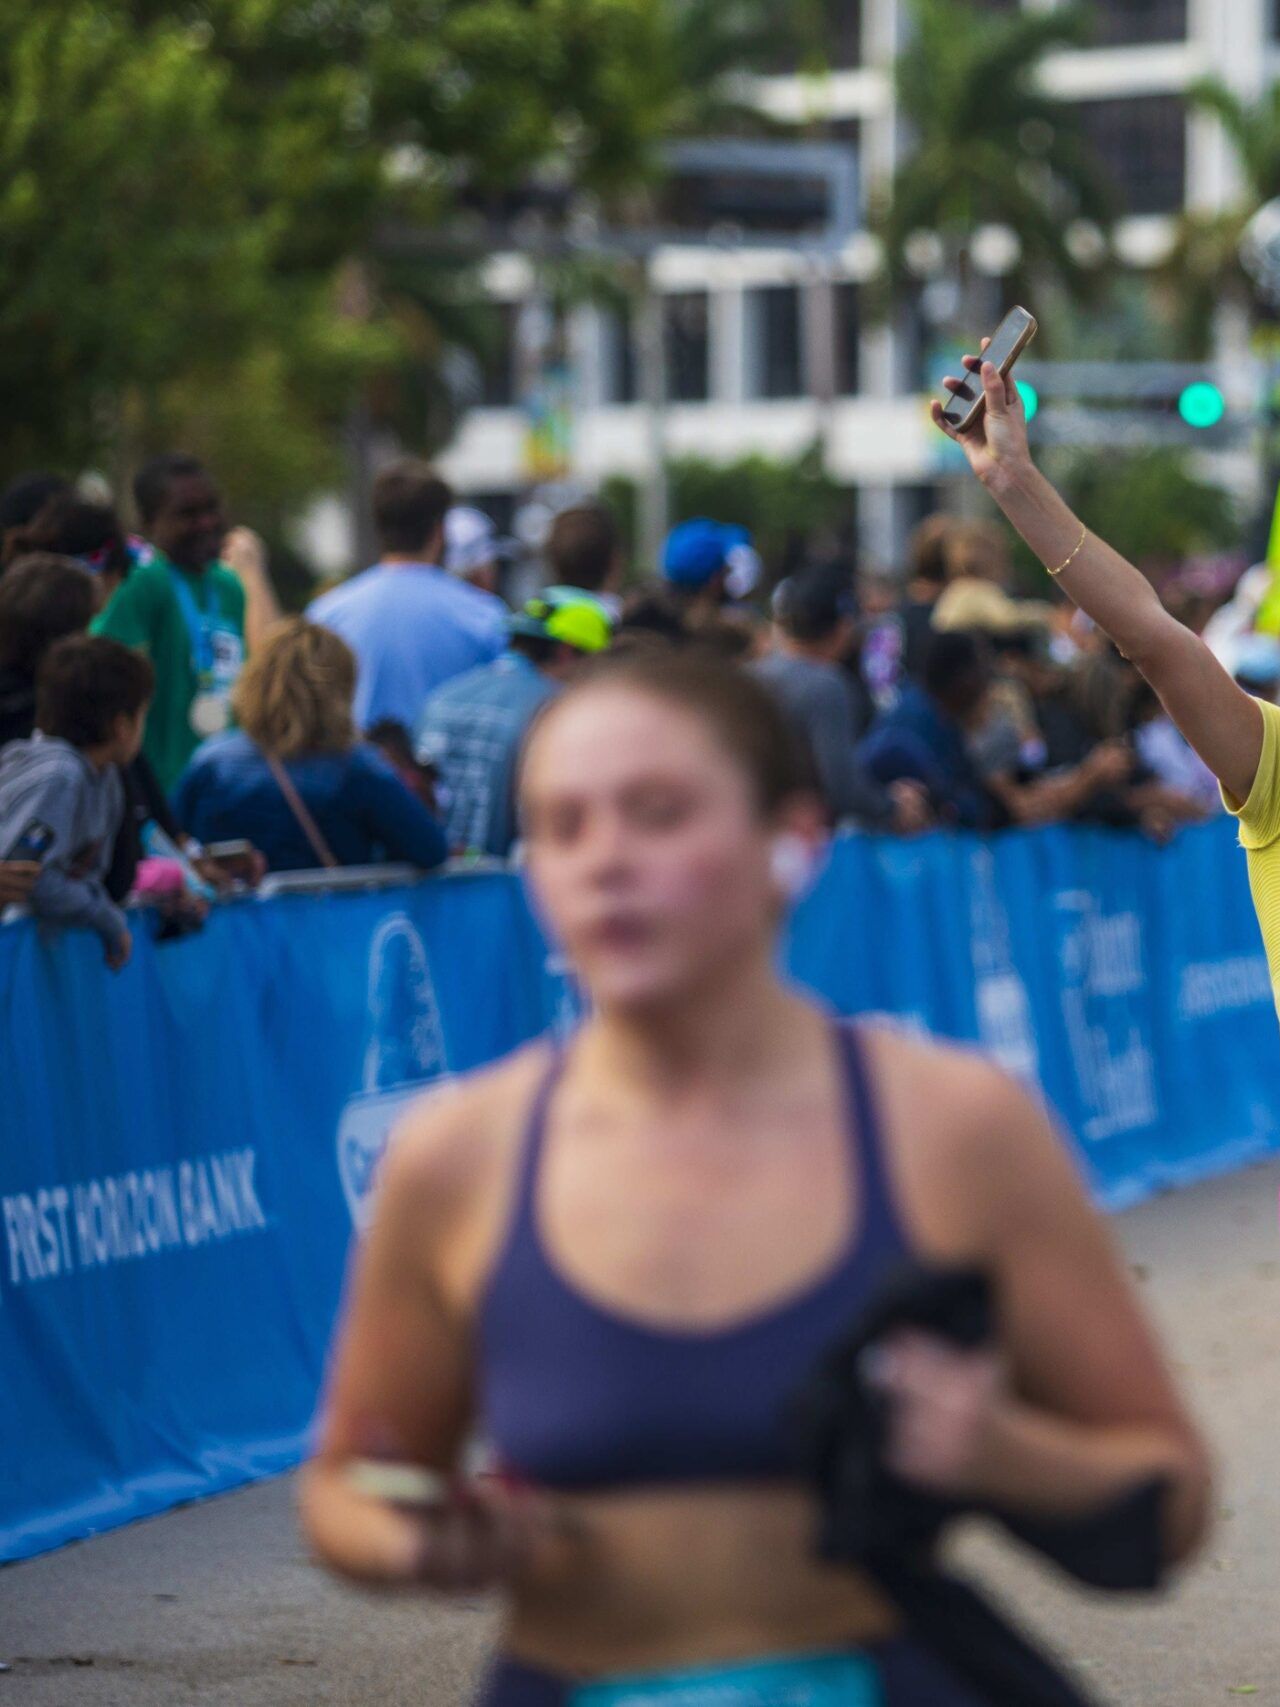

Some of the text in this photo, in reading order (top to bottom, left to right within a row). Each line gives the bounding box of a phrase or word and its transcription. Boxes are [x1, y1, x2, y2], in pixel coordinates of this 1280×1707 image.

[3, 1147, 266, 1283] FIRST HORIZON BANK
